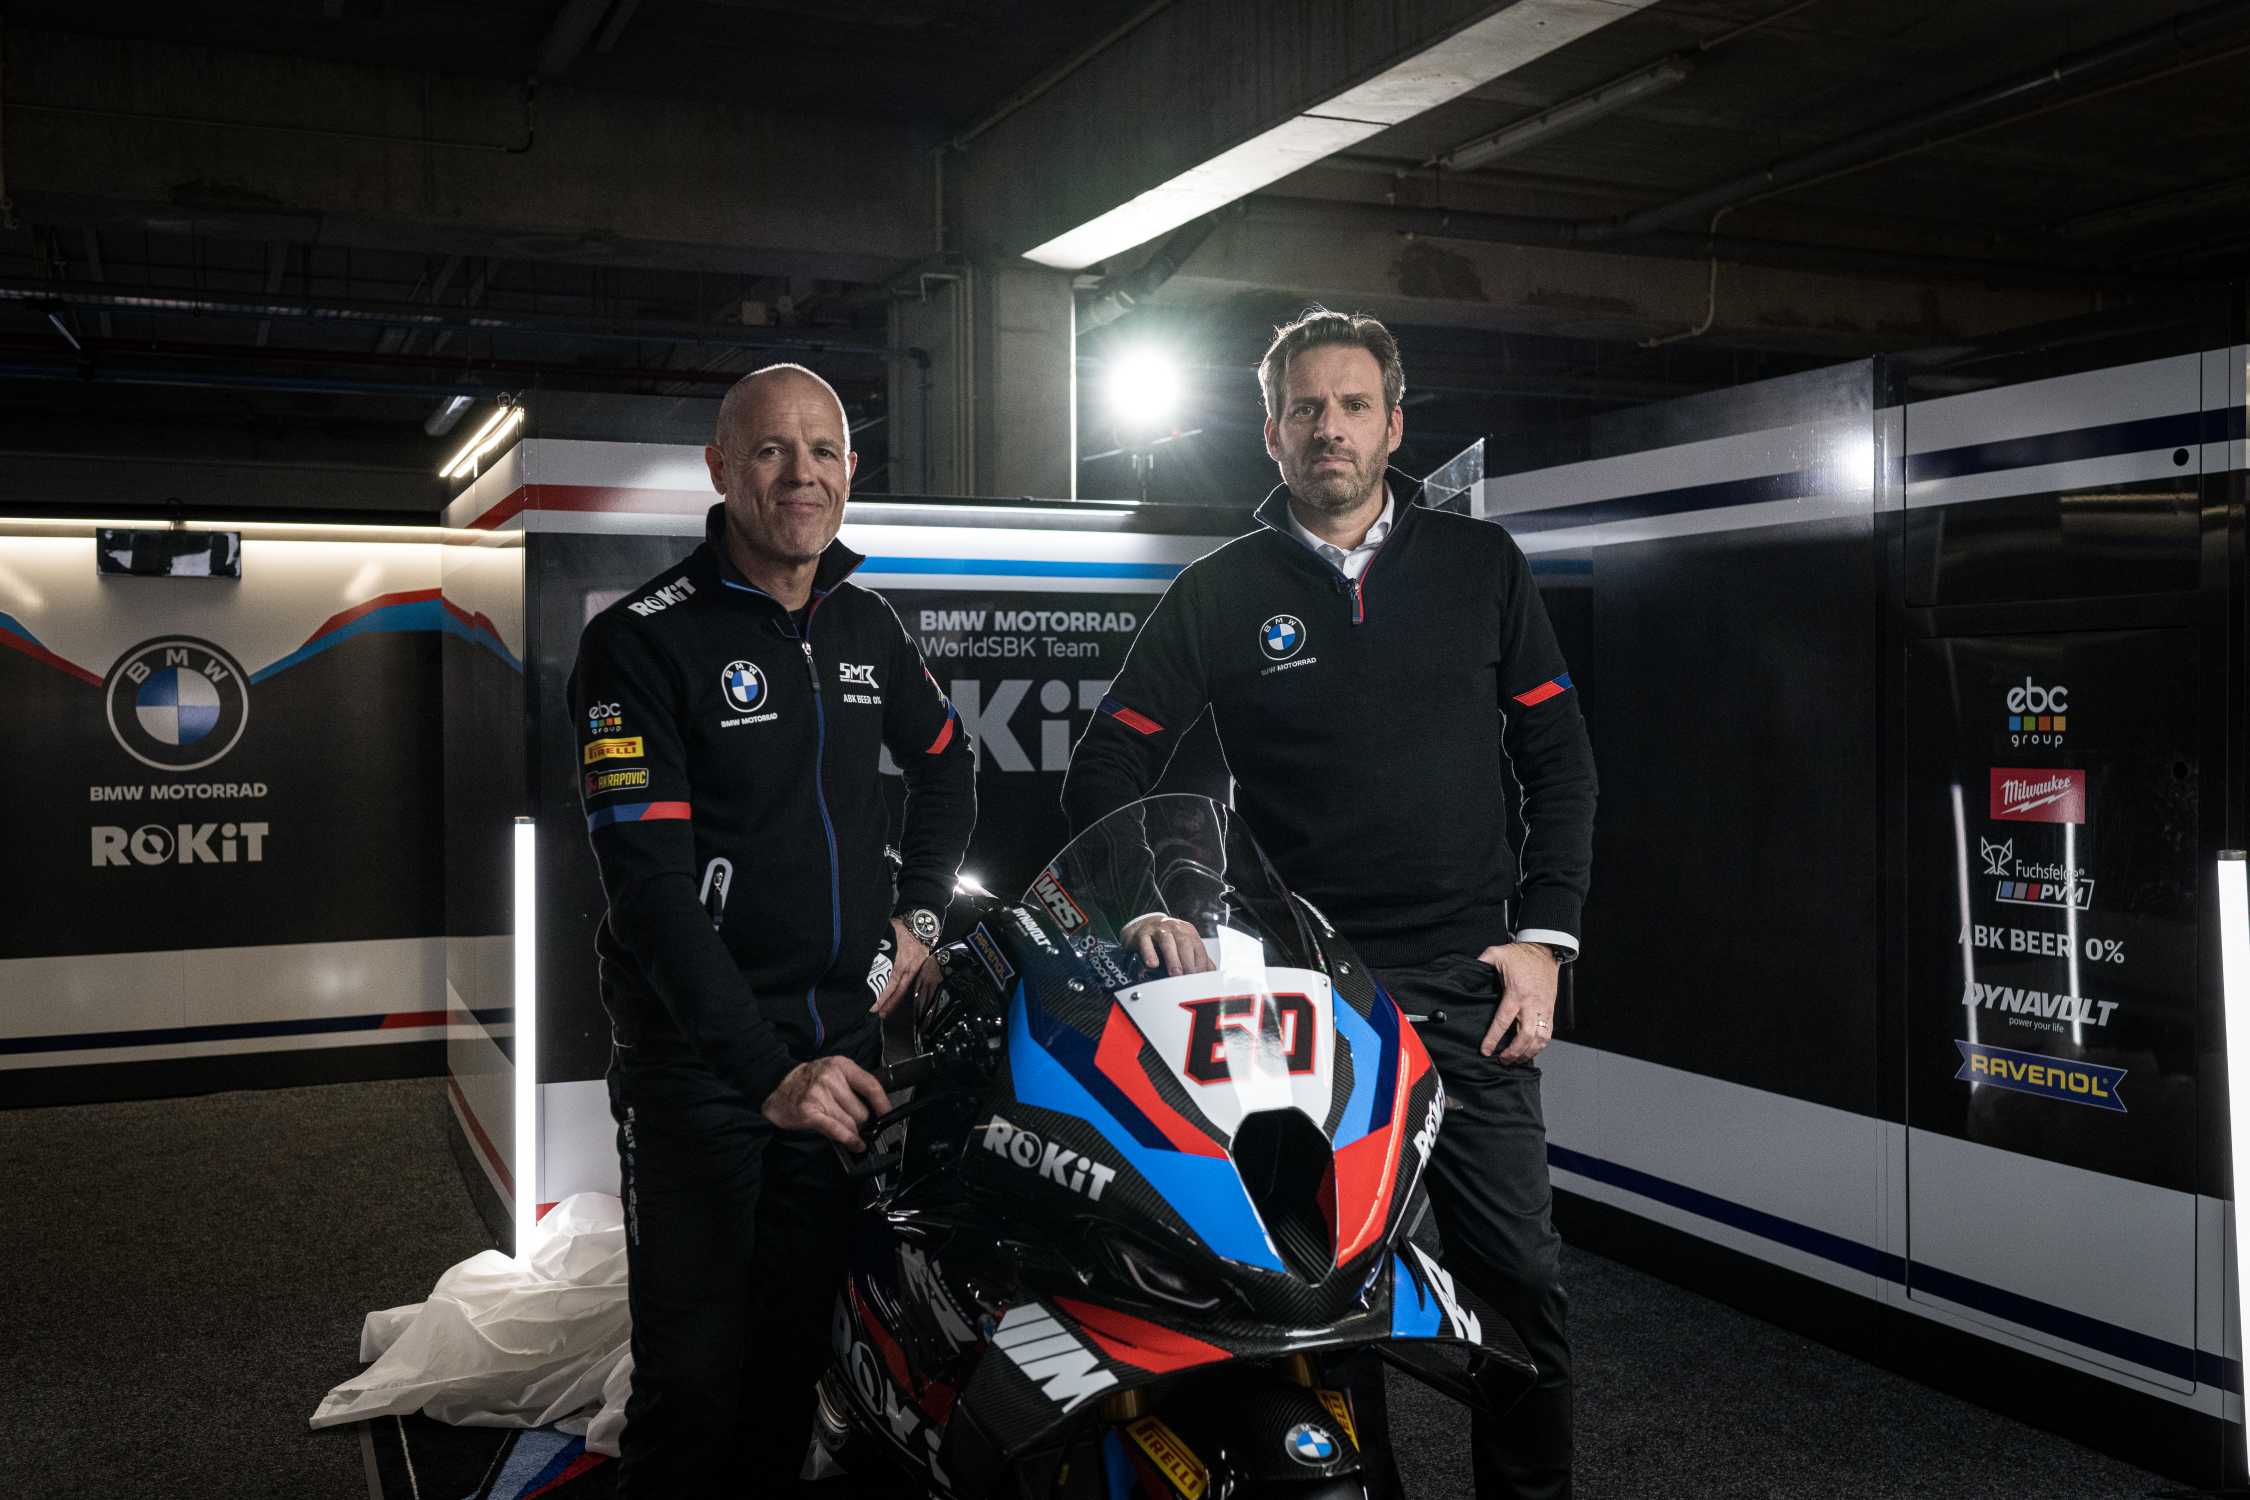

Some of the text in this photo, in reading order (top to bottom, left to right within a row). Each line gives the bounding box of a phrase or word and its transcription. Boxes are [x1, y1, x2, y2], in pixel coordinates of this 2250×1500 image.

[627, 576, 697, 617] ROKiT
[920, 610, 1137, 632] BMW MOTORRAD
[1263, 617, 1297, 633] BMW
[921, 636, 1099, 658] WorldSBK Team
[126, 648, 229, 684] BMW
[725, 663, 757, 679] BMW
[1277, 657, 1317, 672] MOTORRAD
[2006, 676, 2068, 713] ebc
[588, 700, 621, 720] ebc
[720, 719, 740, 728] BMW
[588, 741, 638, 761] PIRELLI
[2011, 734, 2063, 748] group
[89, 782, 268, 801] BMW MOTORRAD
[2000, 774, 2072, 806] Milwaukee
[91, 821, 269, 867] ROKiT
[1011, 907, 1052, 947] DYNAVOLT
[1958, 924, 2125, 964] ABK BEER 0%
[1962, 981, 2119, 1027] DYNAVOLT
[2008, 1017, 2065, 1033] power your life
[1971, 1054, 2109, 1098] RAVENOL
[982, 1114, 1117, 1202] ROKiT
[1135, 1423, 1203, 1492] PIRELLI
